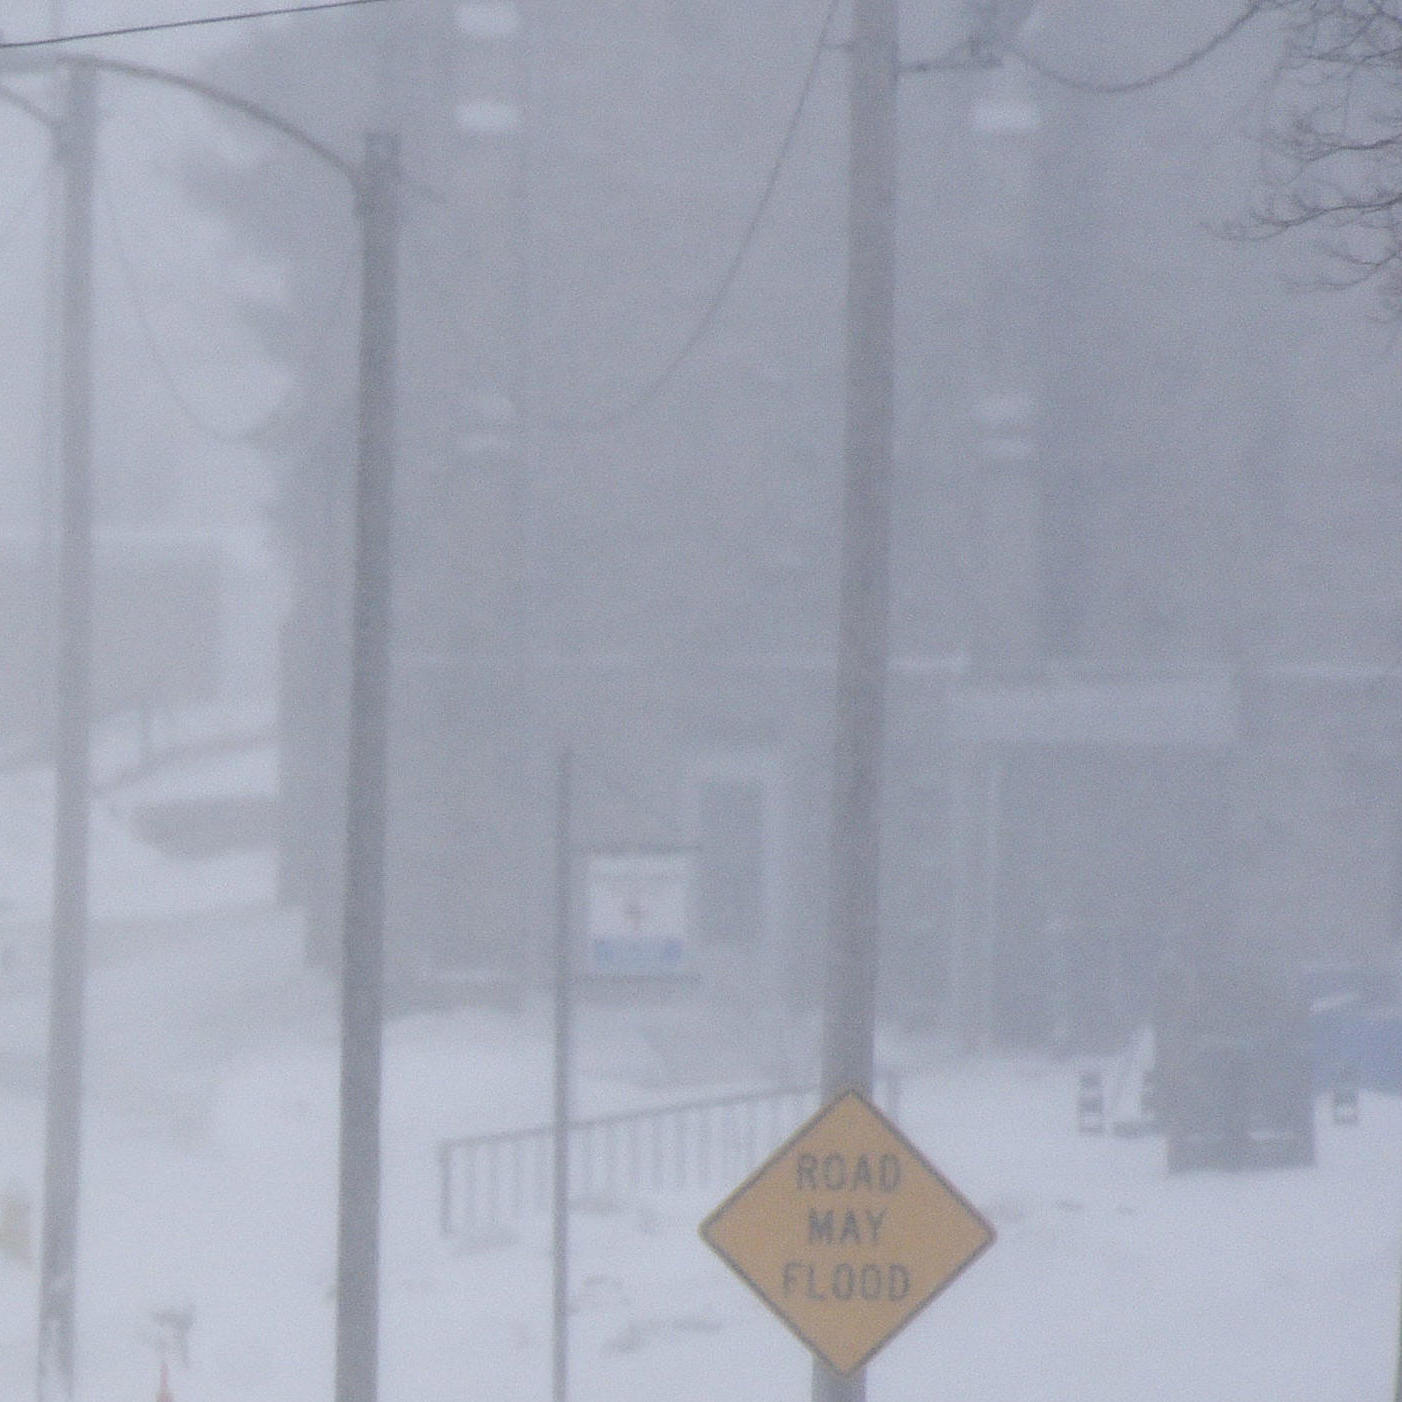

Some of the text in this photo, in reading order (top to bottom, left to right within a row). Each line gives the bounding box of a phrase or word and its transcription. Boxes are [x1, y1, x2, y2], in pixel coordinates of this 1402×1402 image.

[796, 1153, 901, 1192] ROAD
[807, 1207, 886, 1245] MAY
[782, 1263, 911, 1301] FLOOD
